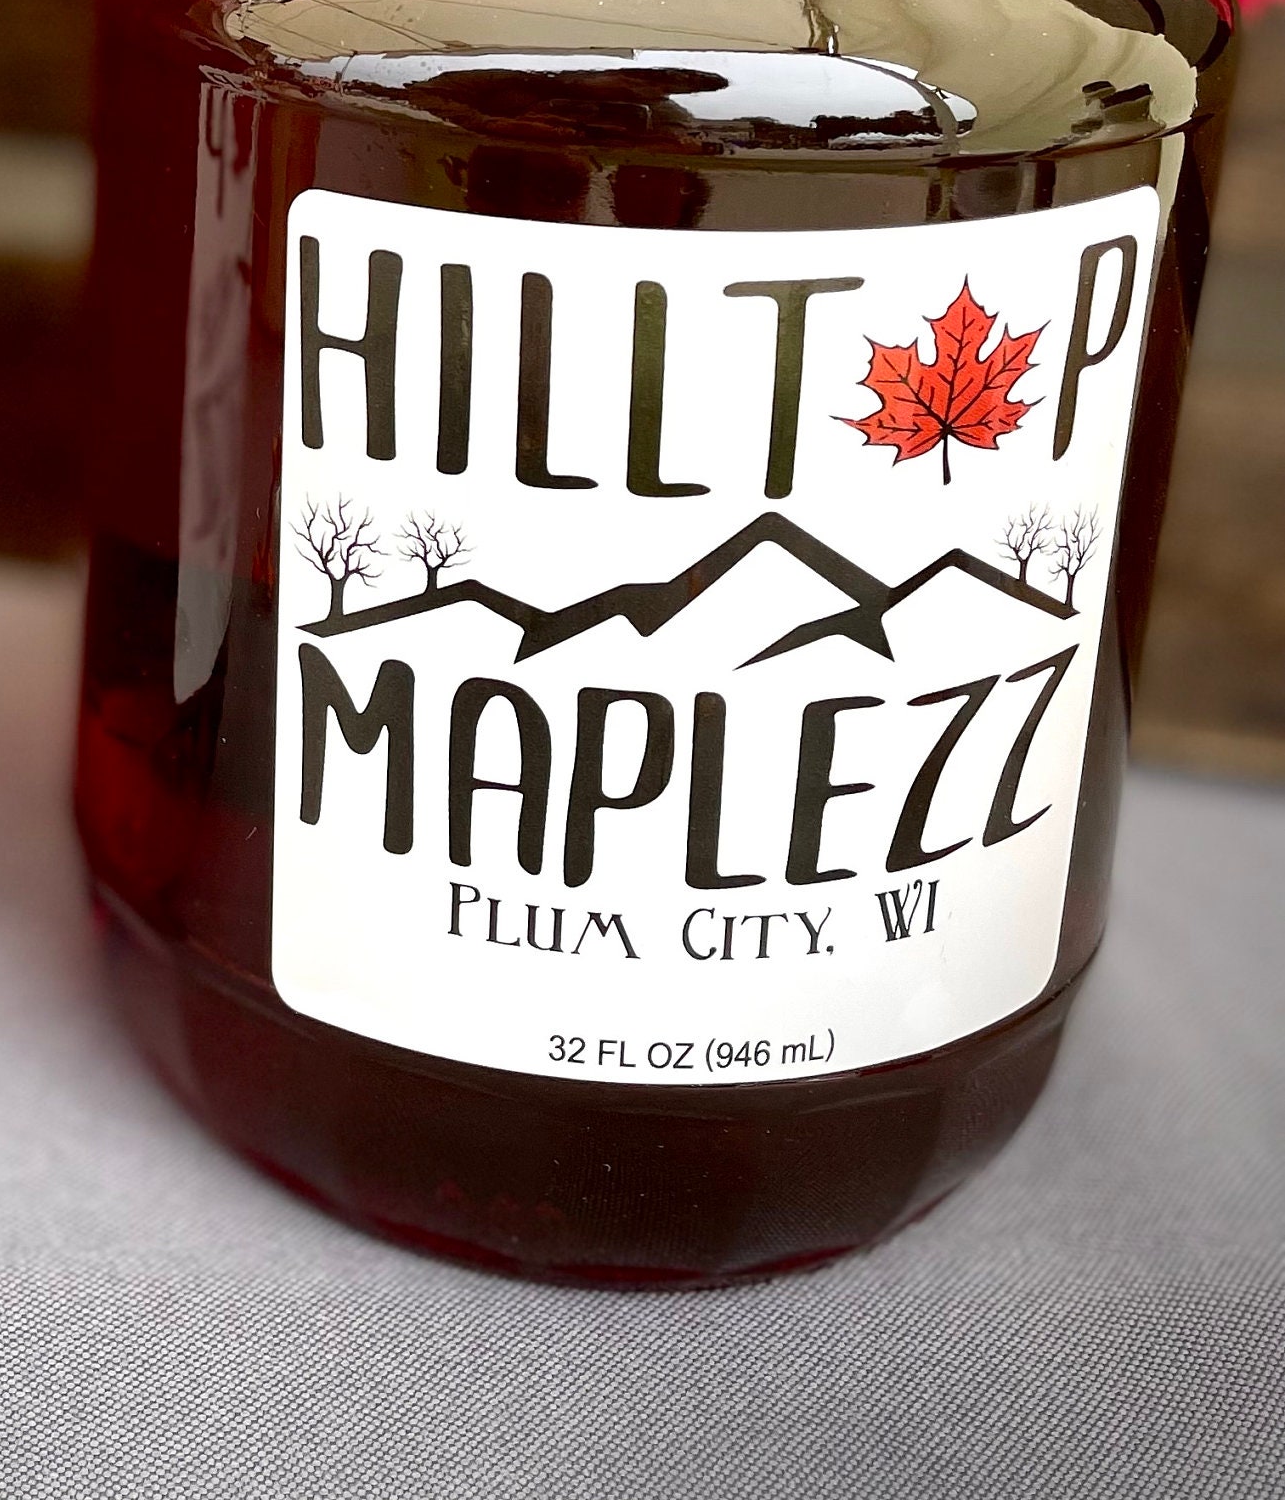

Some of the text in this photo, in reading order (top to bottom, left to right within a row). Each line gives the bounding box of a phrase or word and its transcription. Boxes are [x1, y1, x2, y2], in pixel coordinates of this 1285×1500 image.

[299, 643, 1081, 889] MAPLEZZ
[448, 881, 641, 959] PLUM
[875, 879, 939, 942] WI
[549, 1029, 834, 1072] 32 FL OZ (946 mL)
